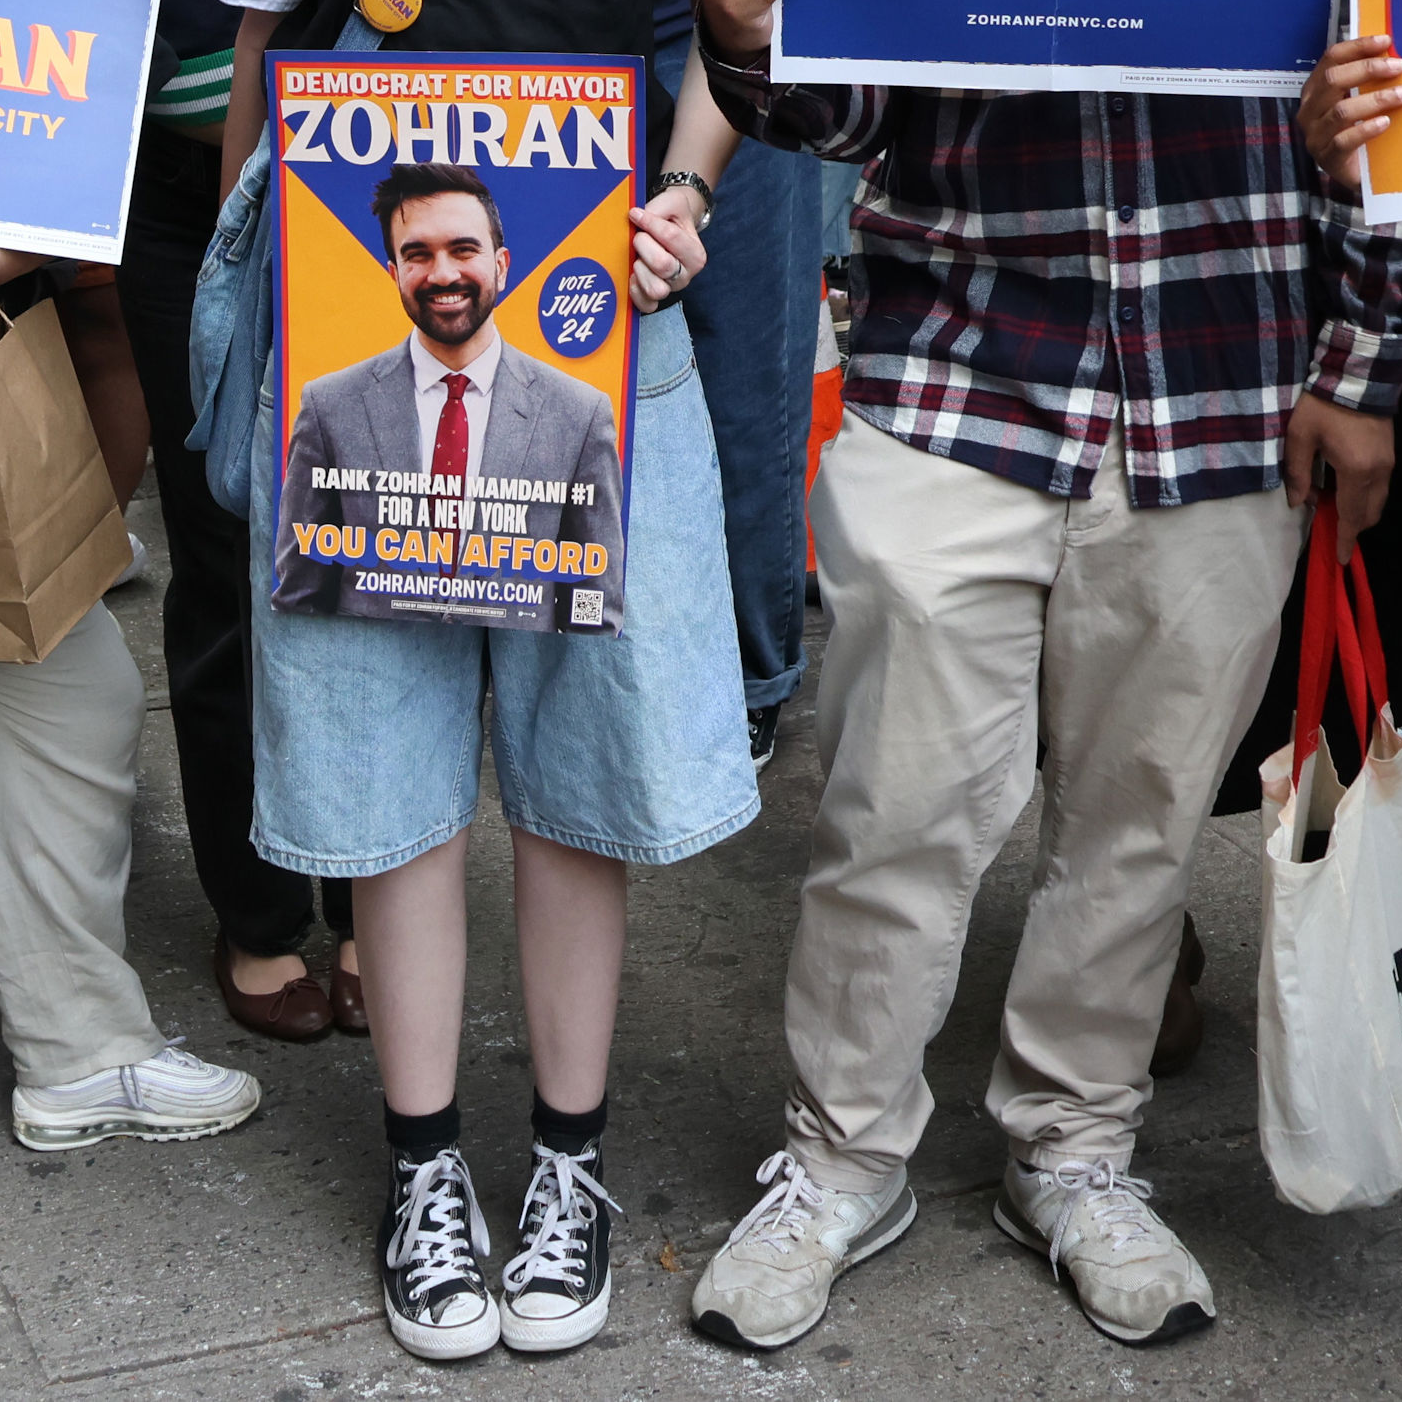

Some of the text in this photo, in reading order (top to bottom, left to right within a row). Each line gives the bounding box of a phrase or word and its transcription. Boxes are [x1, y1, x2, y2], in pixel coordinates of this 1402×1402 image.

[966, 13, 1144, 30] ZOHRANFORNYC.COM
[286, 72, 624, 100] DEMOCRAT FOR MAYOR
[279, 99, 634, 171] ZOHRAN
[557, 274, 597, 292] VOTE
[542, 290, 611, 317] JUNE
[558, 318, 594, 344] 24
[311, 466, 594, 505] RANK ZOHRAN MAMDANI #1
[378, 495, 527, 534] FOR A NEW YORK
[292, 522, 608, 576] YOU CAN AFFORD
[355, 571, 543, 605] ZOHRANFORNYC.COM
